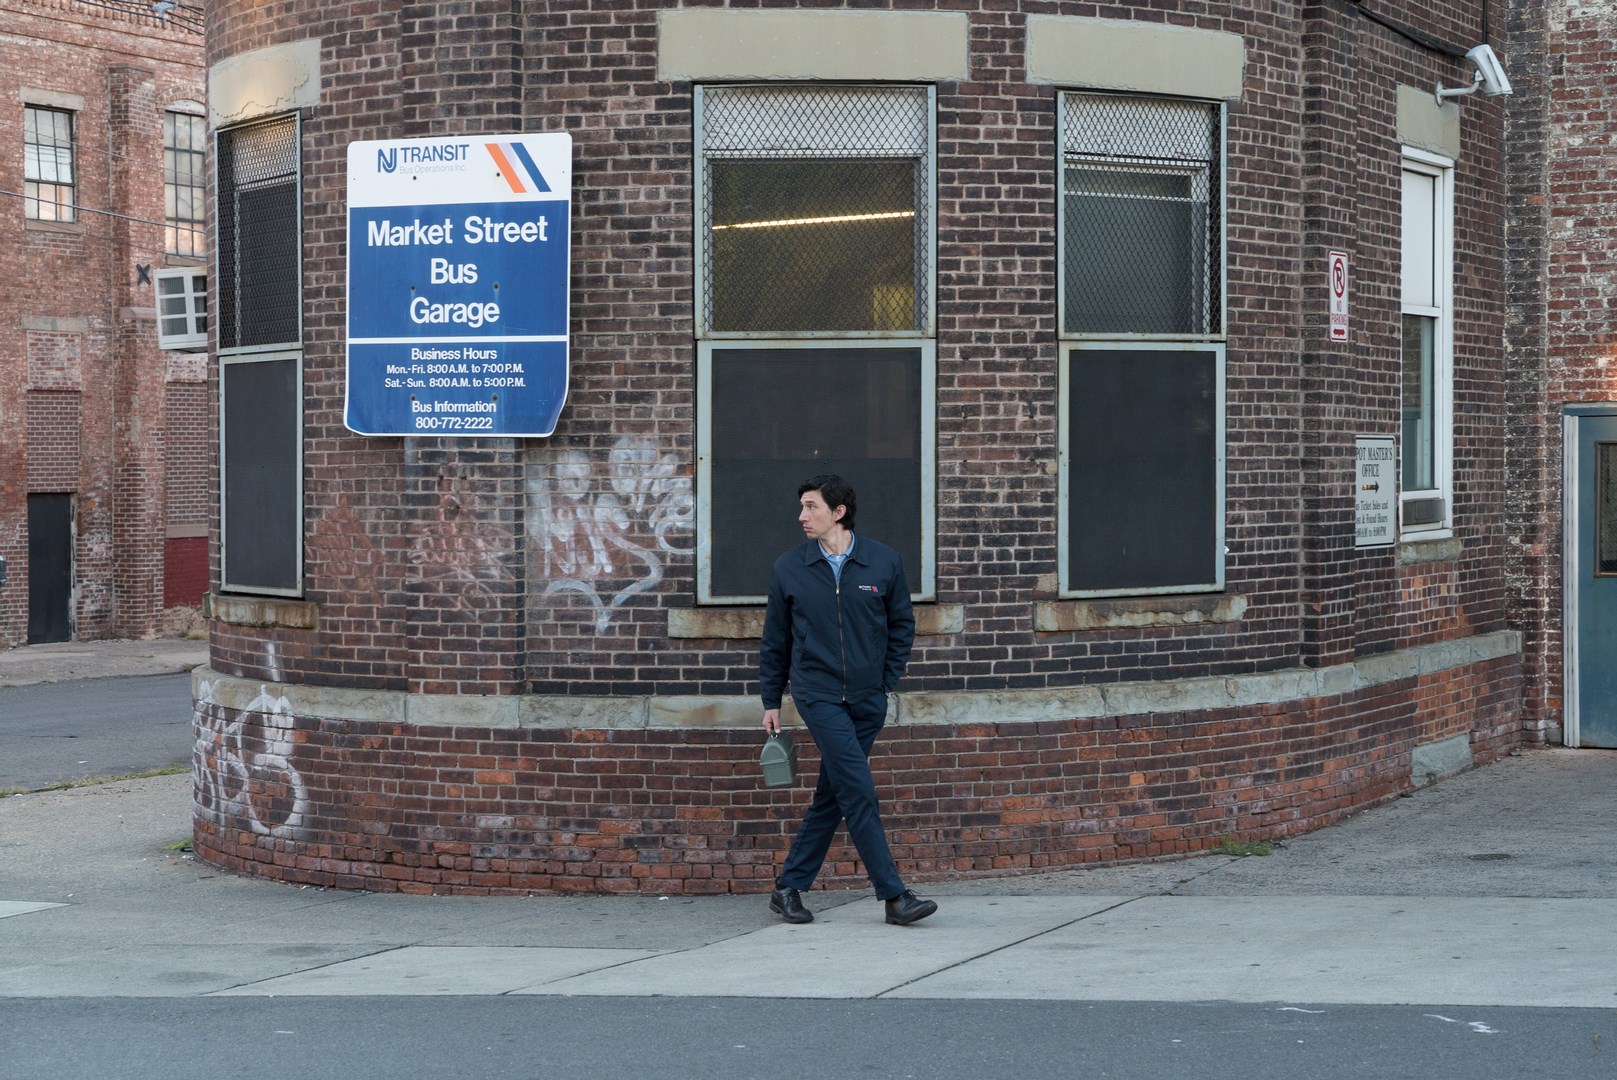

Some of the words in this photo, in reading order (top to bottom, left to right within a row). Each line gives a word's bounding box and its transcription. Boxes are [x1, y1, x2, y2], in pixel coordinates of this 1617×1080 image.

[400, 144, 470, 163] TRANSIT
[399, 166, 413, 174] Bus
[414, 164, 453, 174] Operations
[367, 218, 453, 247] Market
[464, 215, 548, 244] Street
[430, 258, 478, 285] Bus
[409, 296, 500, 328] Garage
[1331, 313, 1347, 325] PARKING
[411, 348, 461, 360] Business
[463, 347, 498, 360] Hours
[471, 364, 481, 373] to
[472, 377, 482, 387] to
[411, 401, 432, 413] Bus
[434, 400, 497, 413] Information
[415, 417, 493, 429] 800-772-2222
[1361, 463, 1379, 477] OFFICE
[1360, 500, 1371, 510] Ticket
